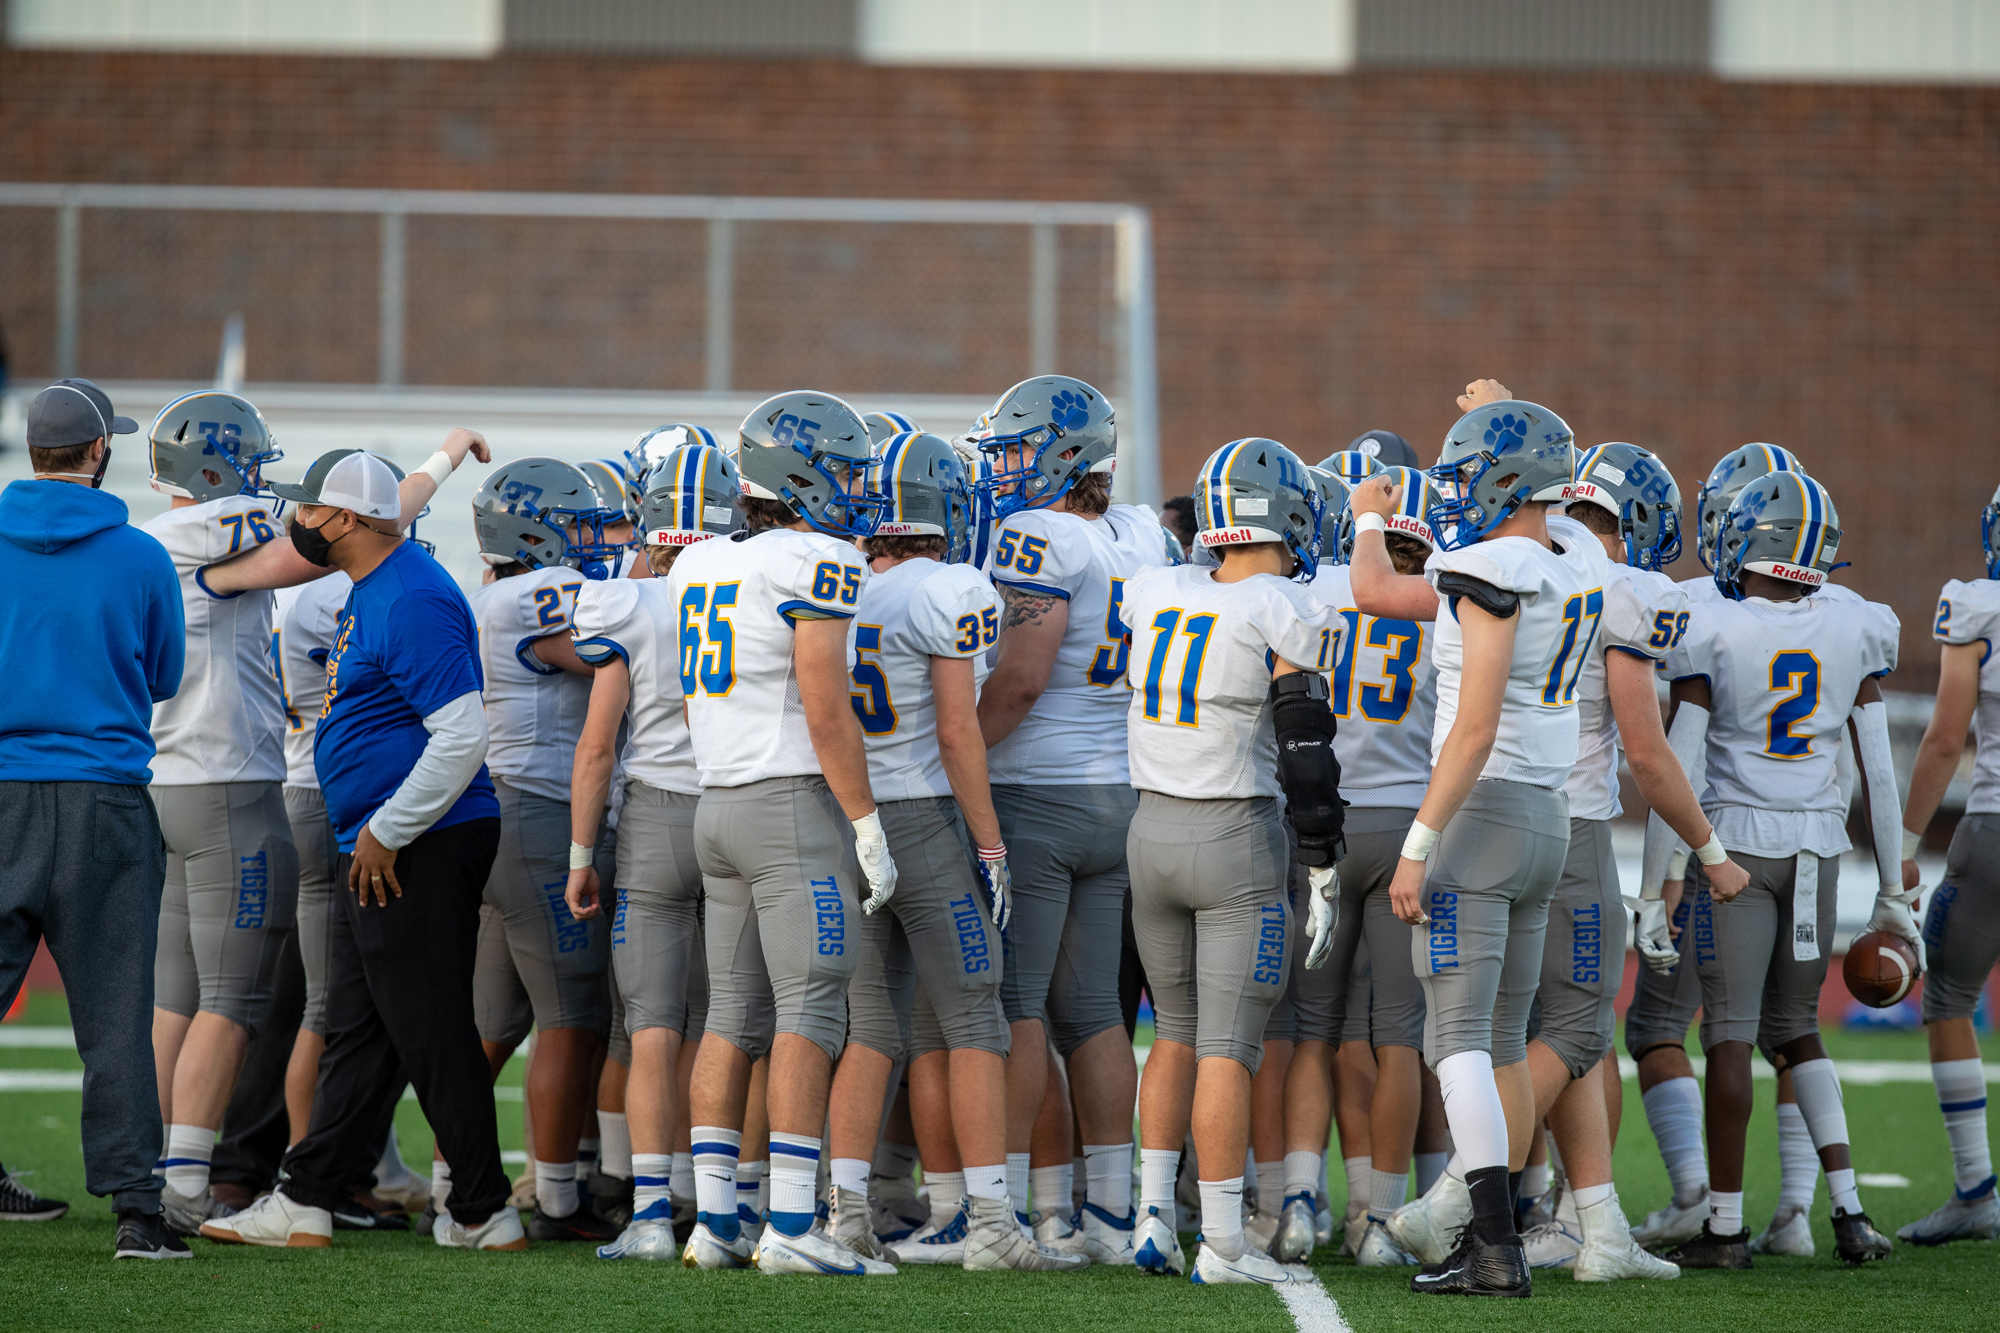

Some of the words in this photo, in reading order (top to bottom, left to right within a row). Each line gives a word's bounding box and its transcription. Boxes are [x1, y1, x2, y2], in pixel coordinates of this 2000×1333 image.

[198, 421, 242, 457] 76
[772, 413, 821, 454] 65
[1276, 456, 1299, 491] 11
[1625, 458, 1667, 506] 58
[500, 481, 544, 519] 27
[219, 509, 275, 555] 76
[995, 528, 1048, 577] 55
[1202, 529, 1252, 546] Riddell
[810, 560, 862, 606] 65
[1771, 564, 1823, 585] Riddell
[678, 580, 742, 698] 65
[955, 603, 999, 654] 35
[1316, 627, 1342, 669] 11
[1541, 586, 1604, 706] 17
[1647, 609, 1690, 650] 58
[1142, 606, 1220, 729] 11
[1331, 607, 1424, 725] 13
[1764, 649, 1822, 759] 2
[235, 850, 268, 929] TIGERS
[810, 876, 844, 956] TIGERS
[950, 893, 990, 974] TIGERS
[1430, 891, 1459, 973] TIGERS
[1694, 890, 1716, 966] TIGERS
[1253, 903, 1286, 985] TIGERS
[1572, 903, 1600, 983] TIGERS
